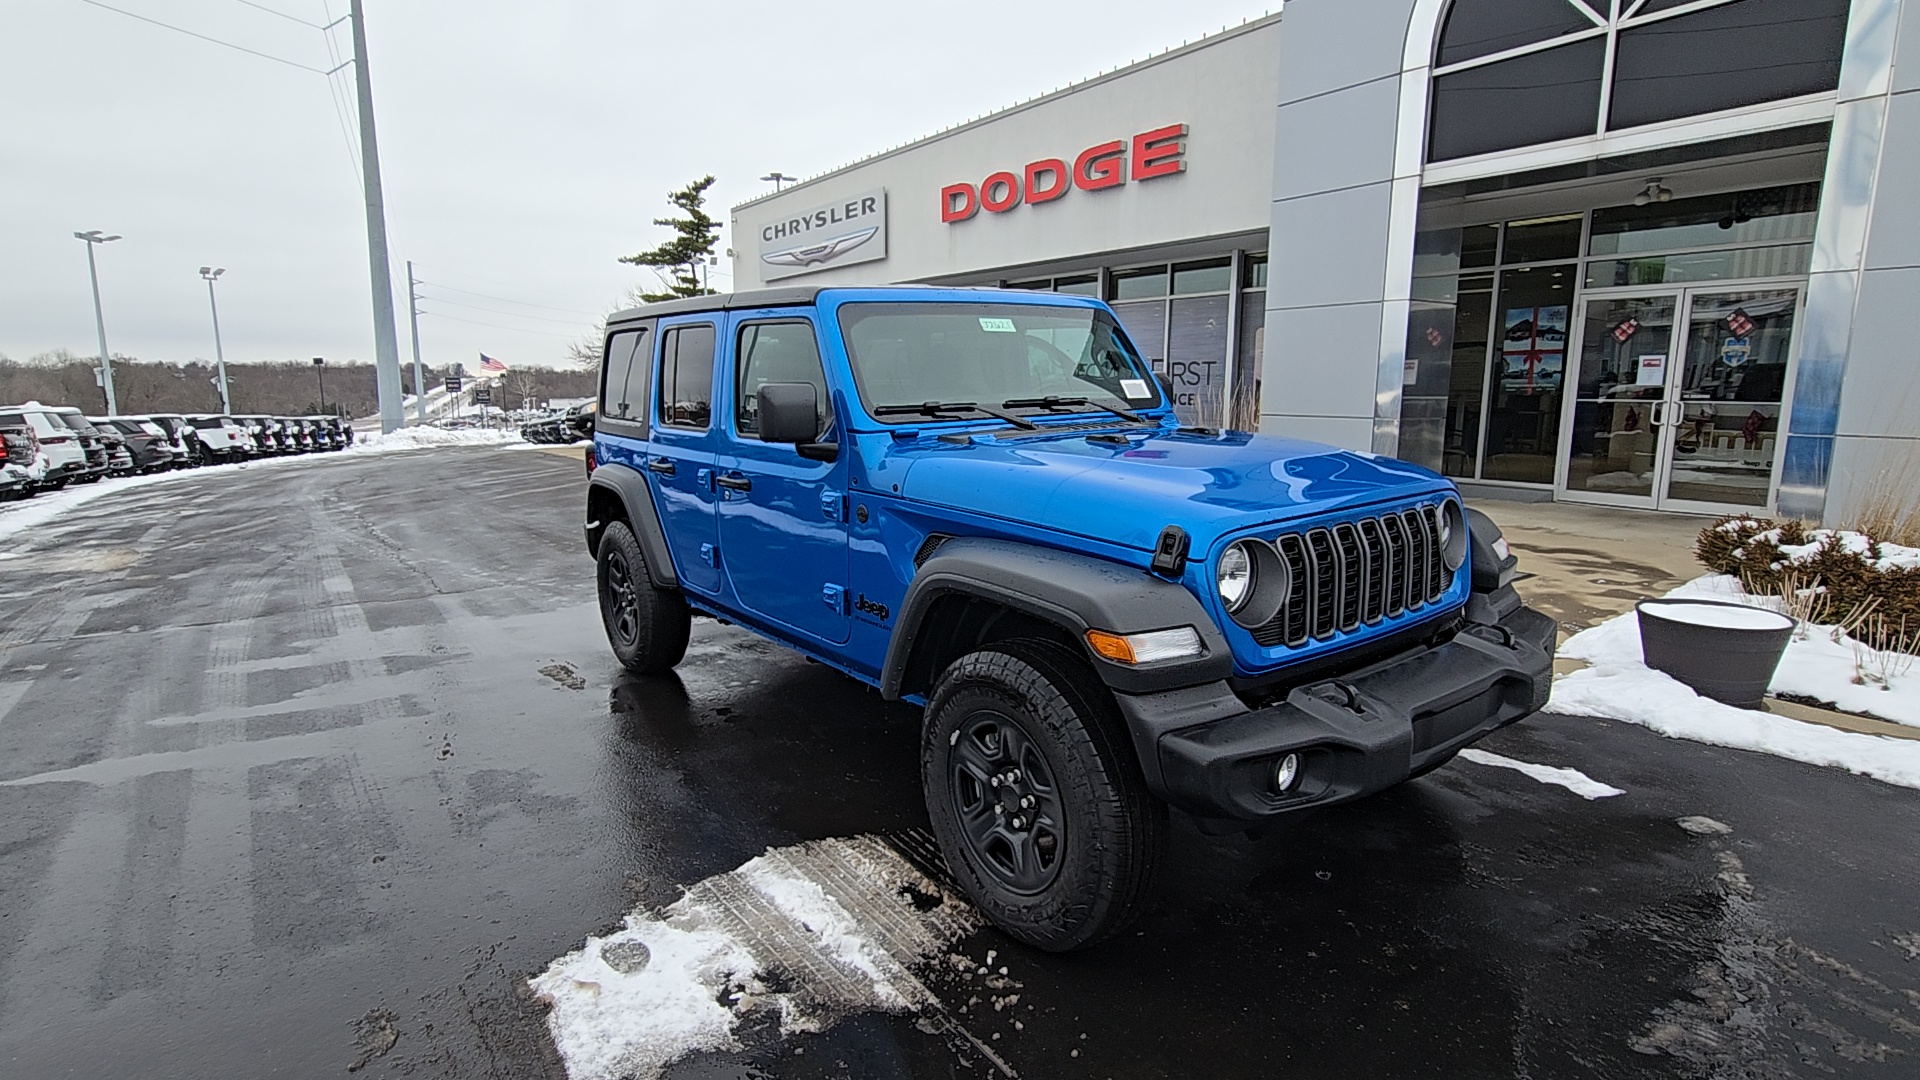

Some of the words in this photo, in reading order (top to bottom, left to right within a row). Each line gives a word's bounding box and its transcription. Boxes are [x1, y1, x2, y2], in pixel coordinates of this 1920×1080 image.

[941, 123, 1188, 223] DODGE
[762, 196, 876, 242] CHRYSLER
[1741, 460, 1760, 468] Jeep
[854, 593, 890, 622] Jeep
